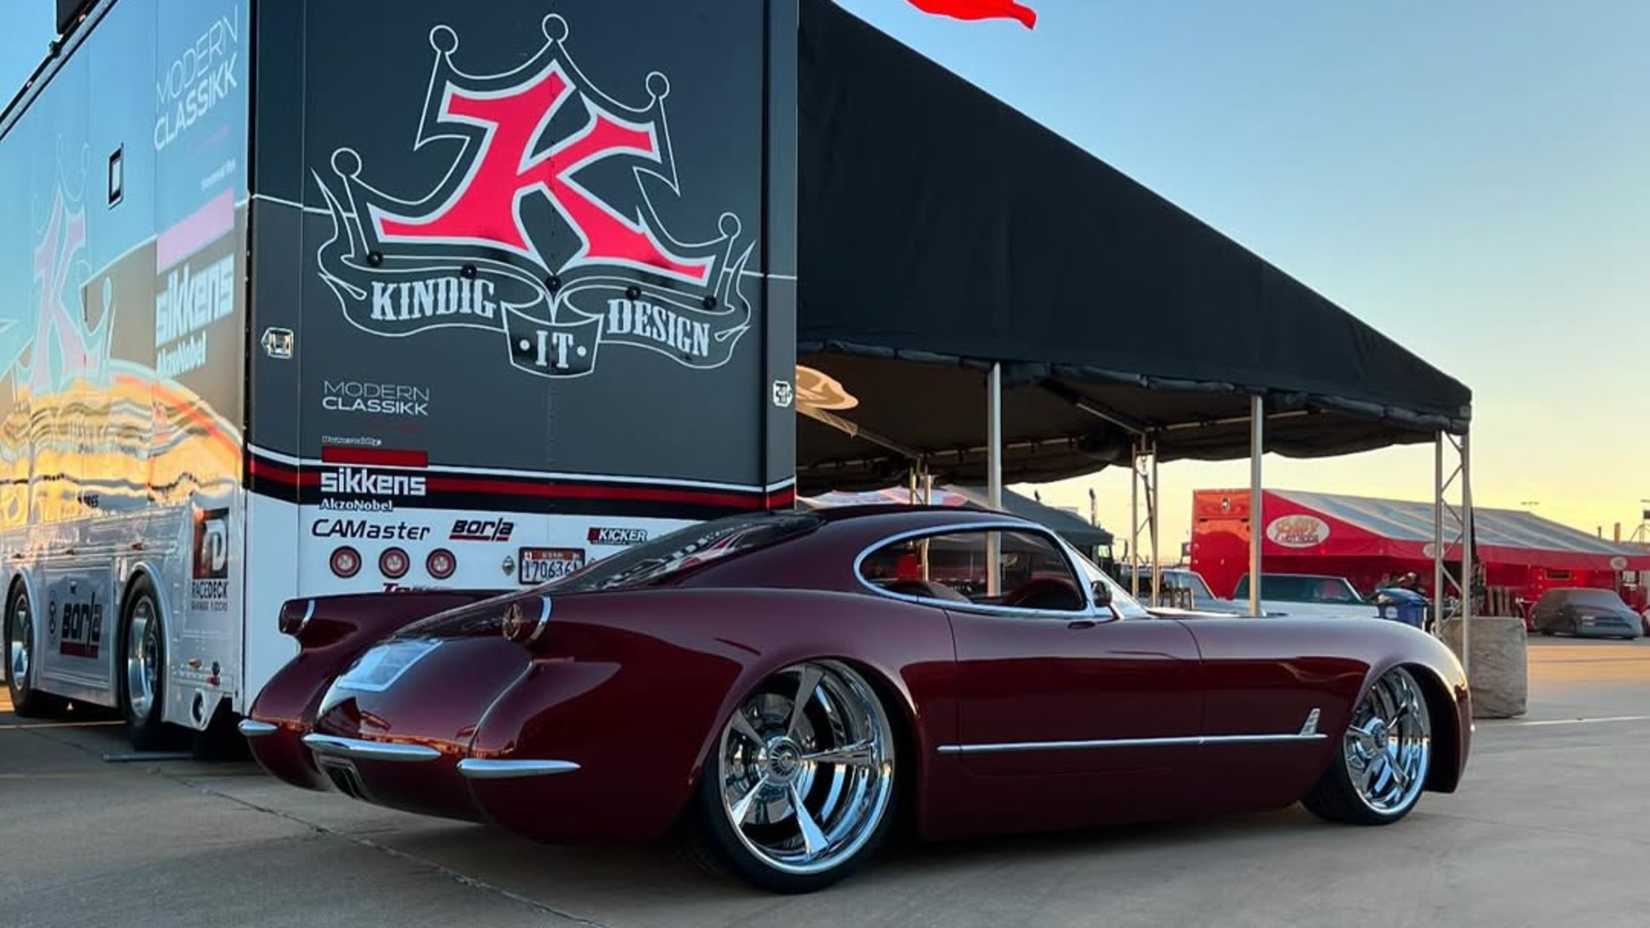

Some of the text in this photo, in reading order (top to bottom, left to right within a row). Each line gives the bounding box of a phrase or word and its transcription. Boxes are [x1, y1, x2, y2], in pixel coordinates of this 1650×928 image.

[157, 4, 238, 104] MODERN
[154, 53, 237, 150] CLASSIKK
[156, 254, 234, 347] sikkens
[371, 277, 710, 368] KINDIG IT DESIGN
[324, 381, 429, 401] MODERN
[322, 396, 429, 415] CLASSIKK
[321, 467, 426, 496] sikkens
[320, 498, 393, 511] AkzoNobel
[312, 519, 430, 541] CAMaster
[598, 528, 648, 542] KICKER
